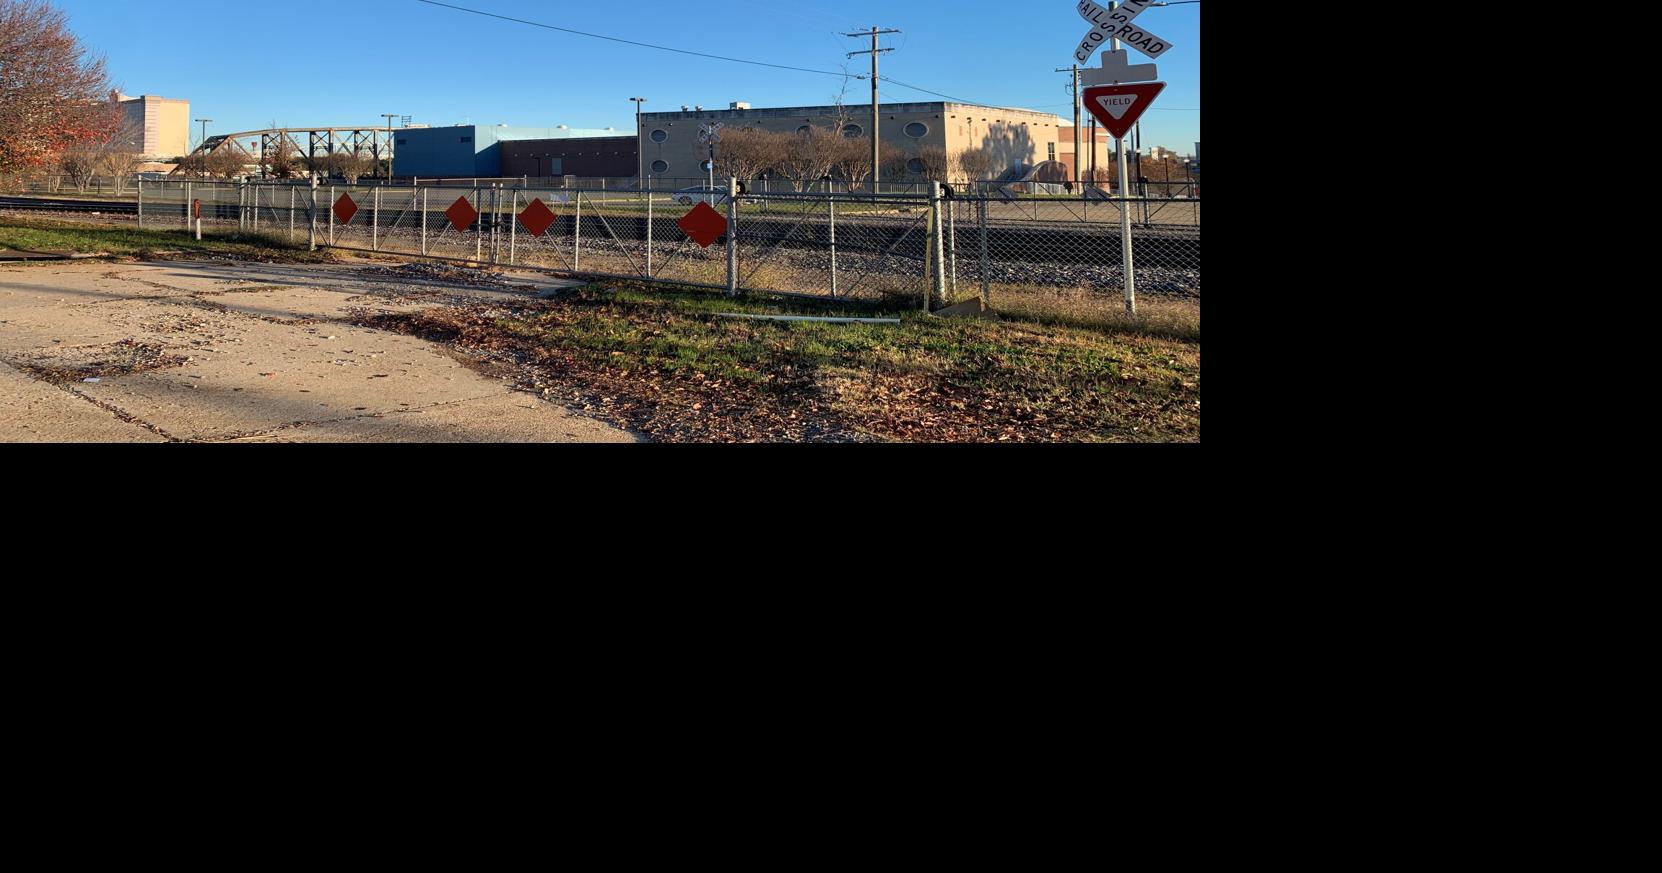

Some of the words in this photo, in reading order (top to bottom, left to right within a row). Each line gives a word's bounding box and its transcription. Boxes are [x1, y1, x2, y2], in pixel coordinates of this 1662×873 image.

[1076, 0, 1149, 61] CROSSIN
[1114, 24, 1164, 54] ROAD
[1103, 97, 1131, 106] YIELD
